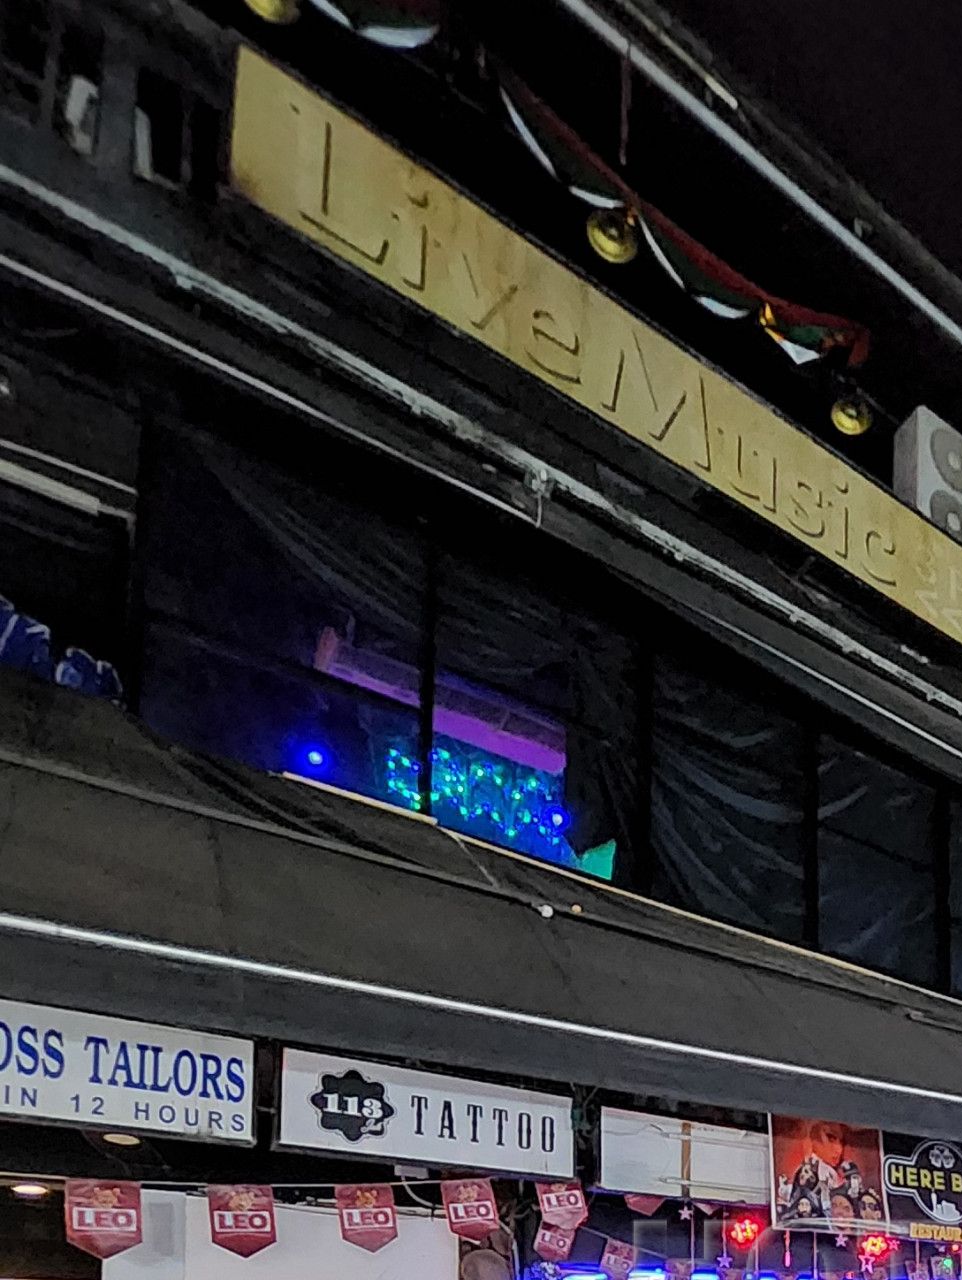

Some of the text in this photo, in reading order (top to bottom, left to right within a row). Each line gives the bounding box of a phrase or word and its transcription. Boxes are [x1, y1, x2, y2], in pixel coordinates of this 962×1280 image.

[84, 1036, 245, 1103] TAILORS
[4, 1085, 245, 1132] IN 12 HOURS
[323, 1093, 383, 1119] 113
[411, 1095, 555, 1152] TATTOO
[891, 1164, 946, 1190] HERE
[453, 1203, 491, 1219] LEO
[546, 1193, 580, 1208] LEO
[77, 1209, 133, 1230] LEO
[218, 1213, 268, 1230] LEO
[346, 1209, 393, 1226] LEO
